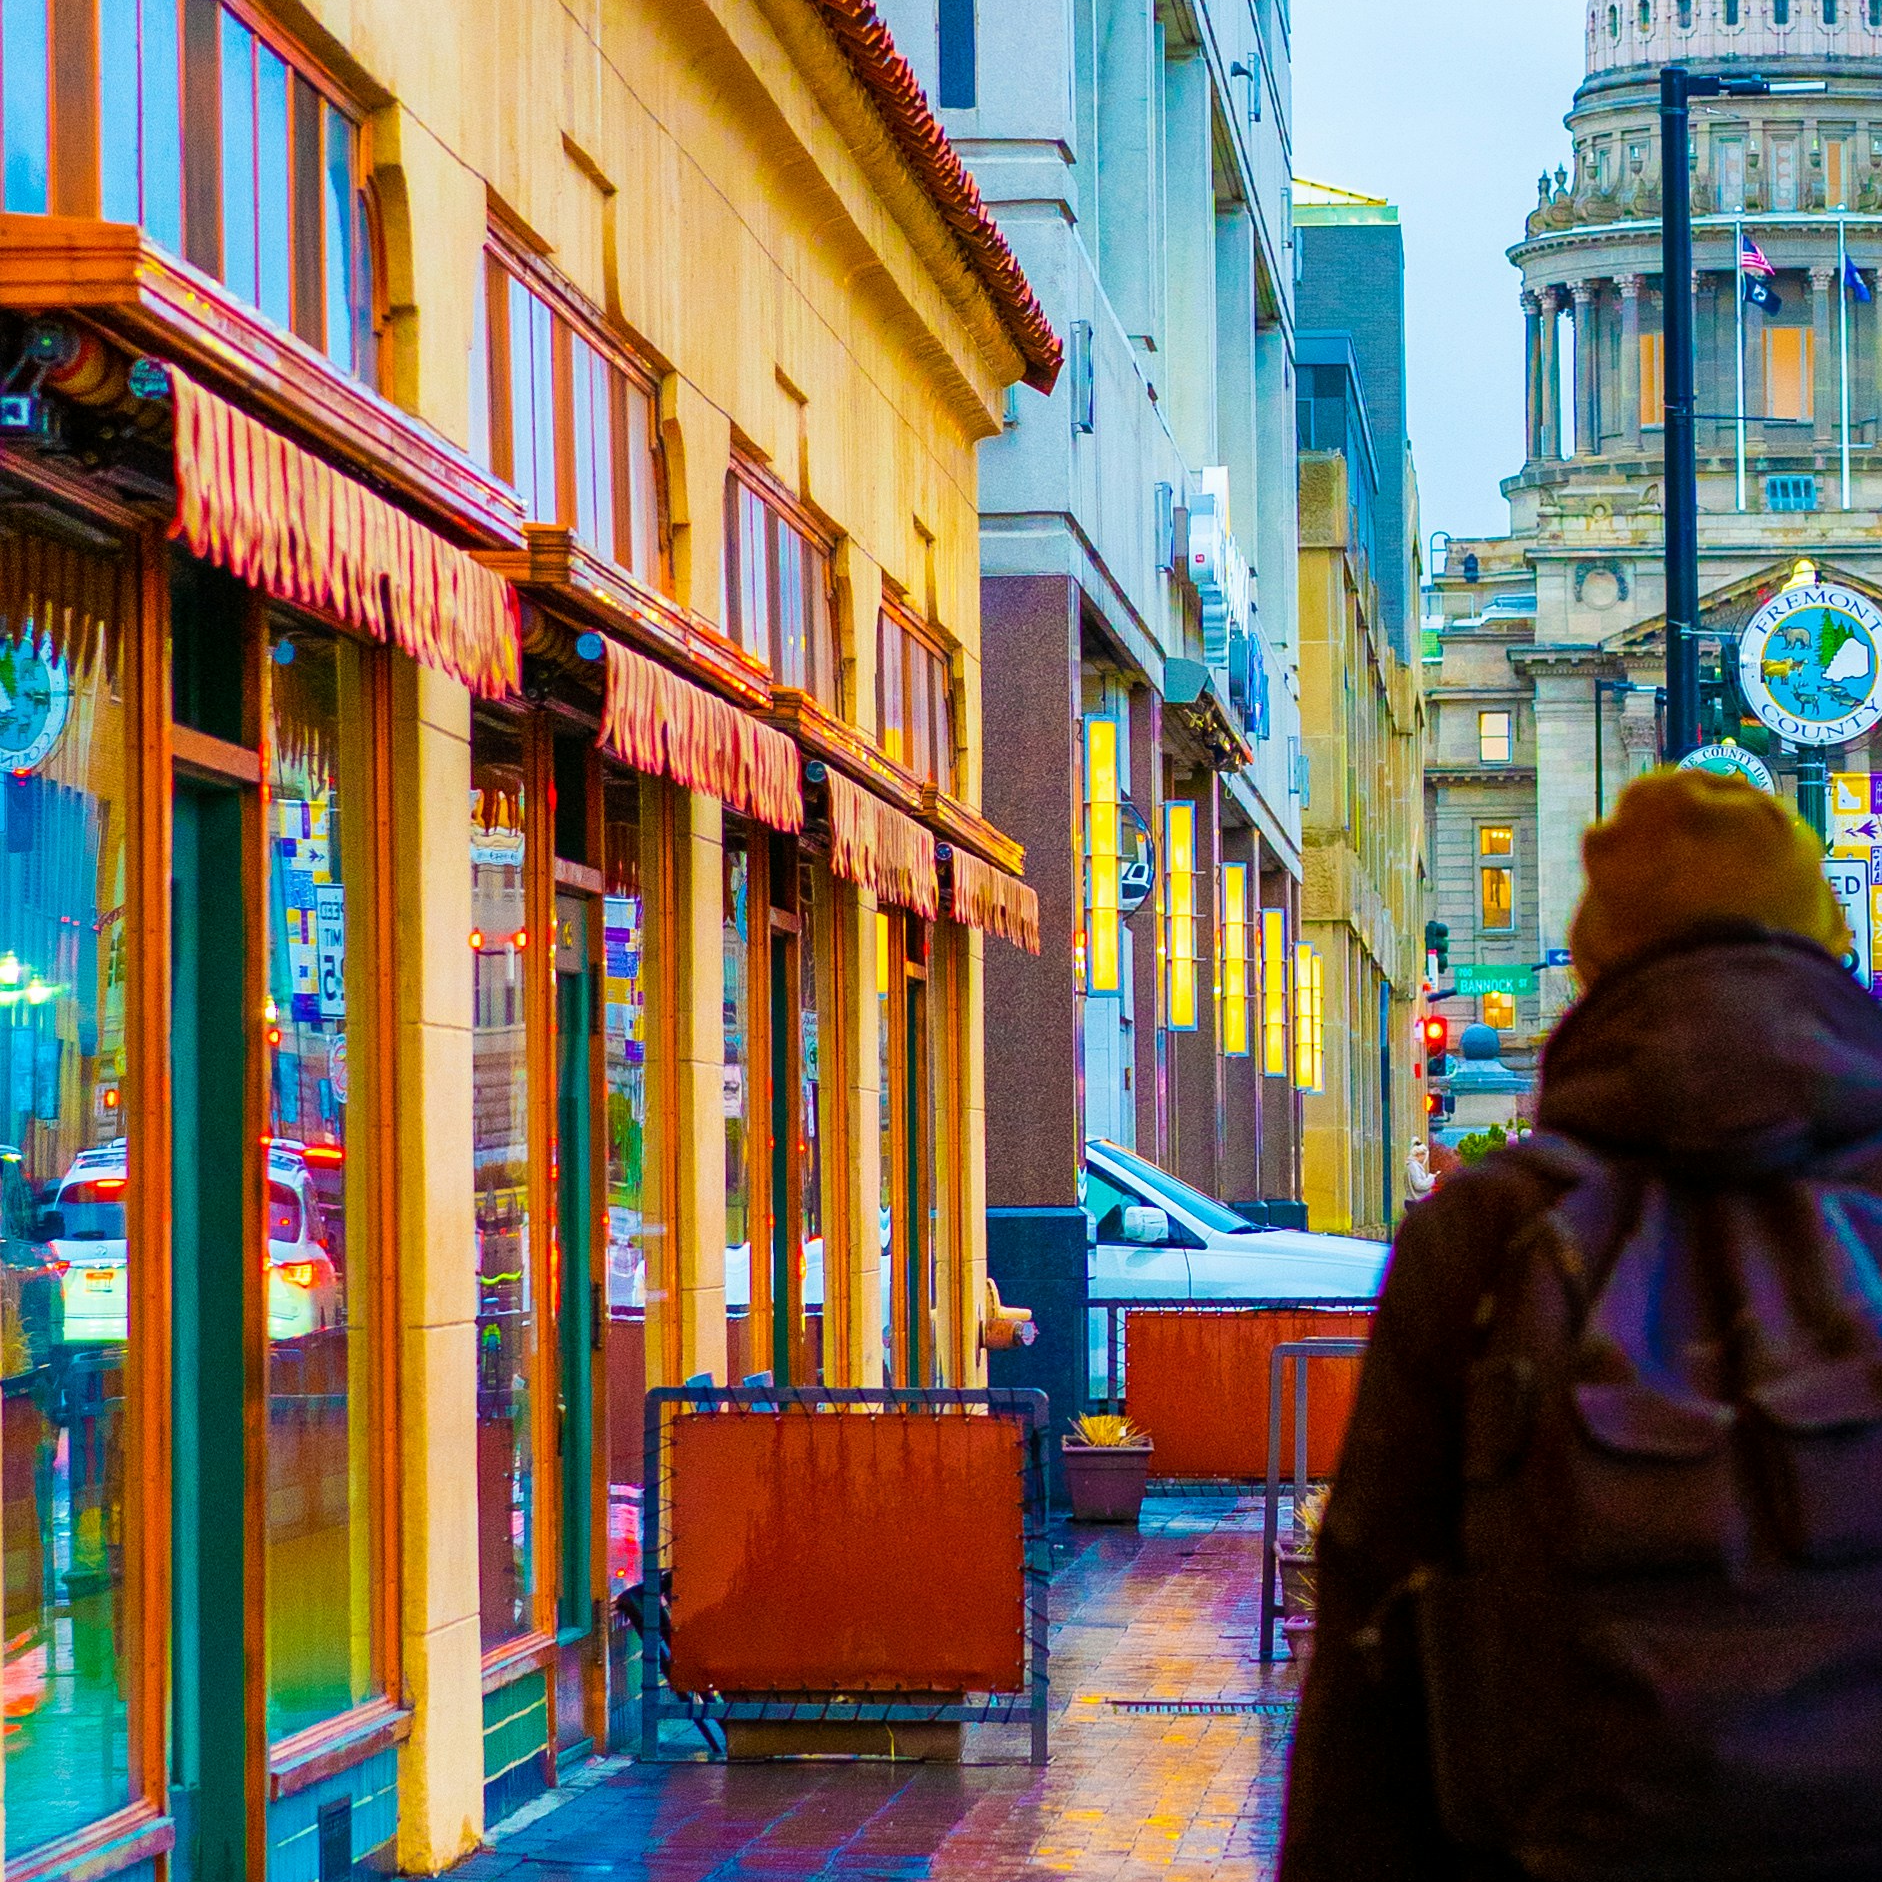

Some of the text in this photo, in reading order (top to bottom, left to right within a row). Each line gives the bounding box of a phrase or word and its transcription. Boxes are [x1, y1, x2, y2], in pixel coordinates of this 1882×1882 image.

[1762, 697, 1880, 739] COUNTY
[1702, 747, 1754, 766] COUNTY
[1754, 766, 1769, 788] IDA
[1459, 968, 1472, 977] 700
[1460, 979, 1527, 993] BANNOCK ST
